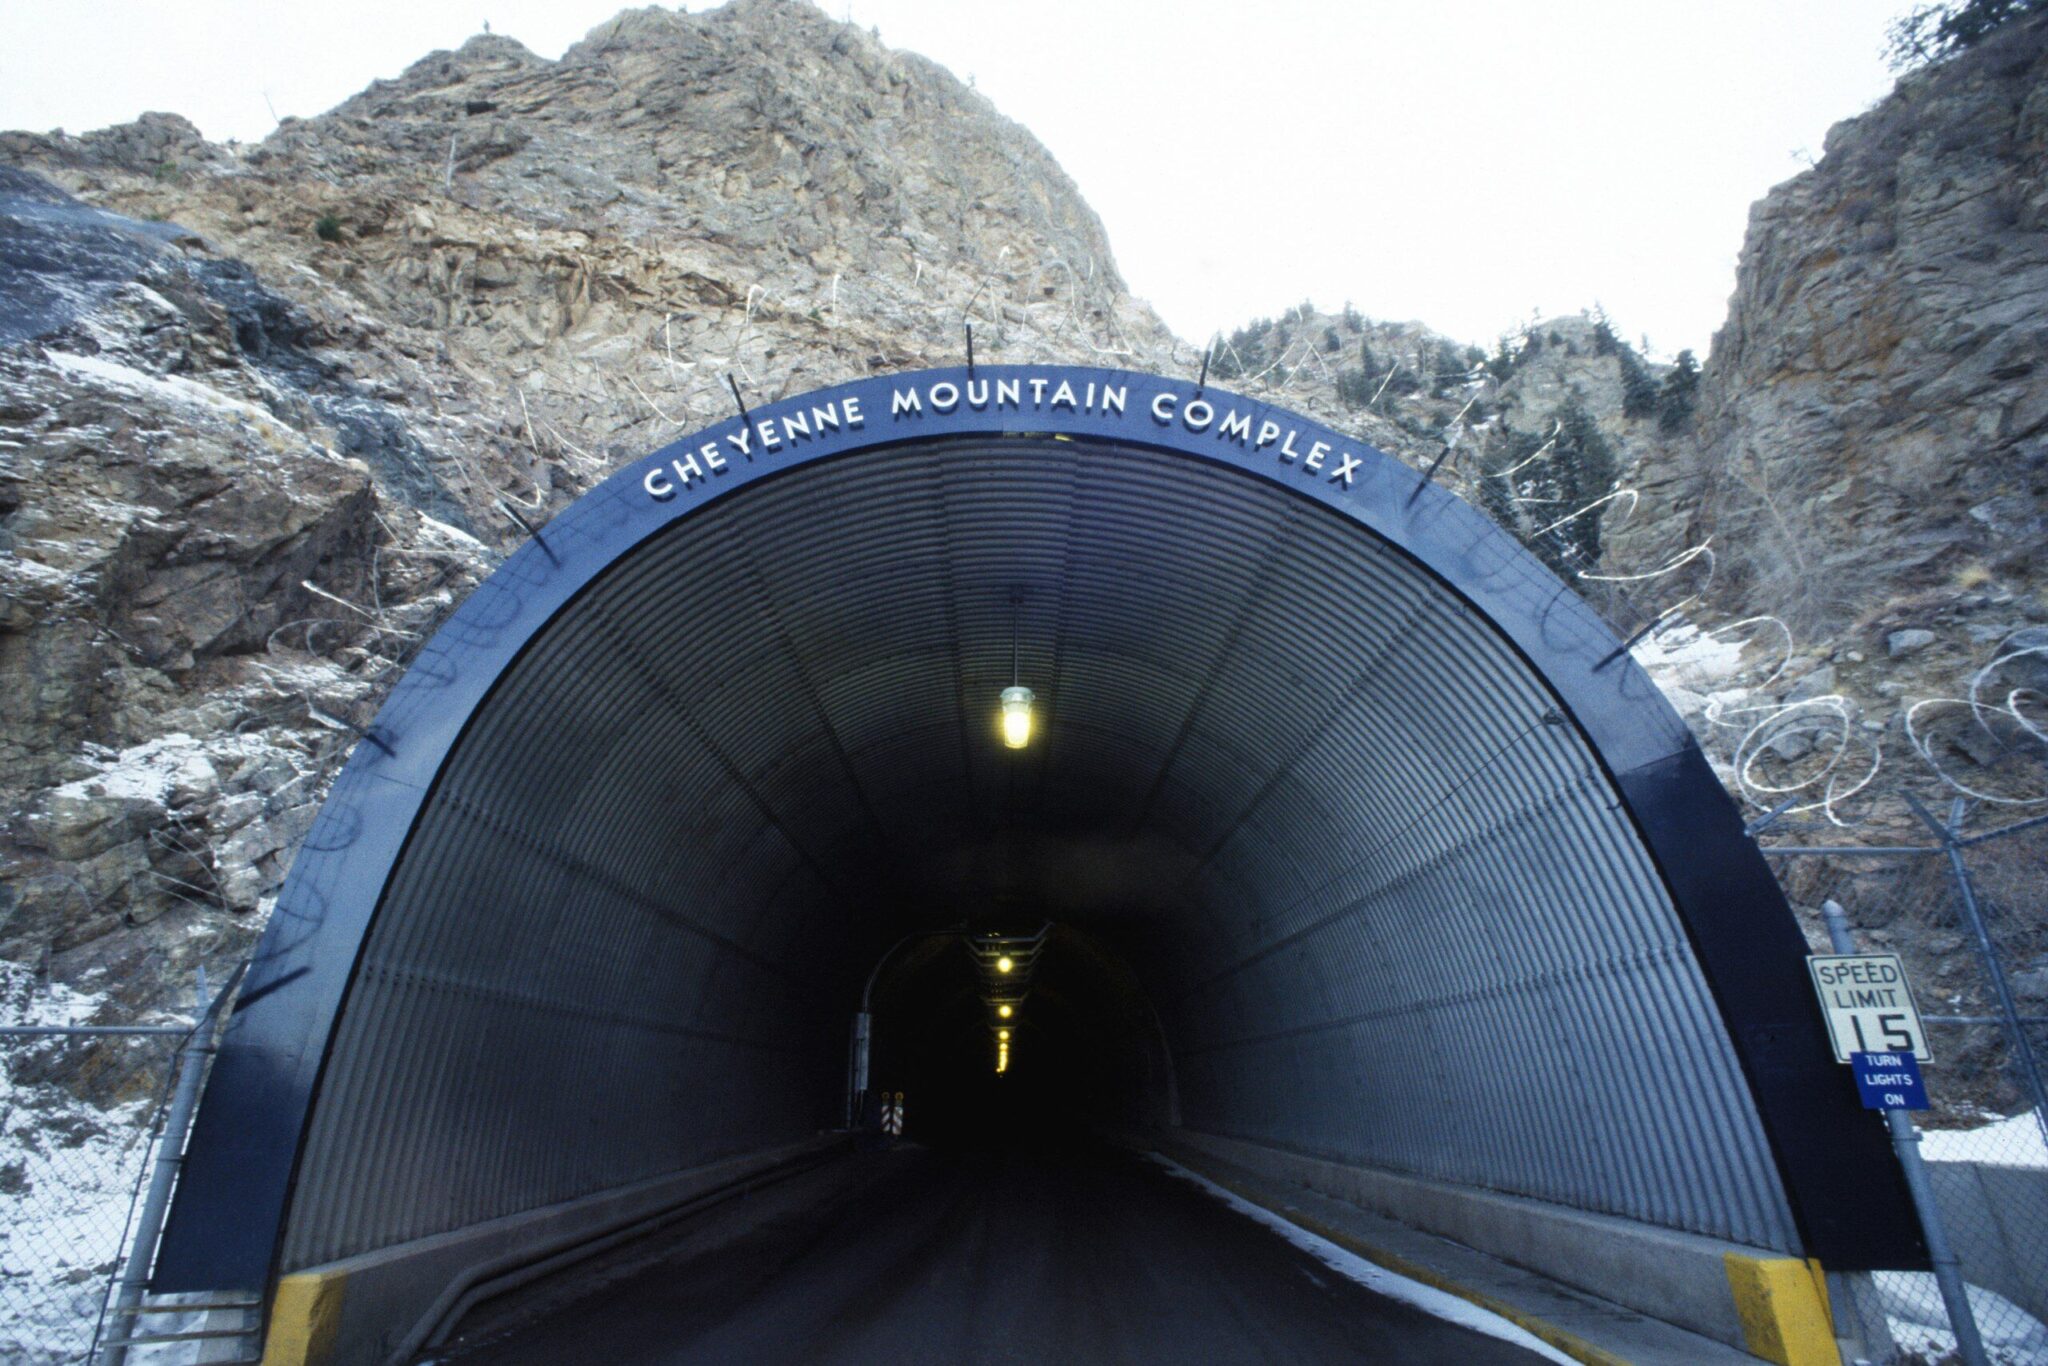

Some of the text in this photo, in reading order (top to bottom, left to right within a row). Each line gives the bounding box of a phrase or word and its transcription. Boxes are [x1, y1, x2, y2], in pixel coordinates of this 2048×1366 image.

[643, 378, 1363, 497] CHEYENNE MOUNTAIN COMPLEX
[1819, 963, 1898, 985] SPEED
[1833, 989, 1897, 1009] LIMIT
[1850, 1014, 1915, 1052] 15
[1865, 1054, 1903, 1066] TURN
[1864, 1073, 1914, 1086] LIGHTS
[1884, 1093, 1905, 1106] ON
